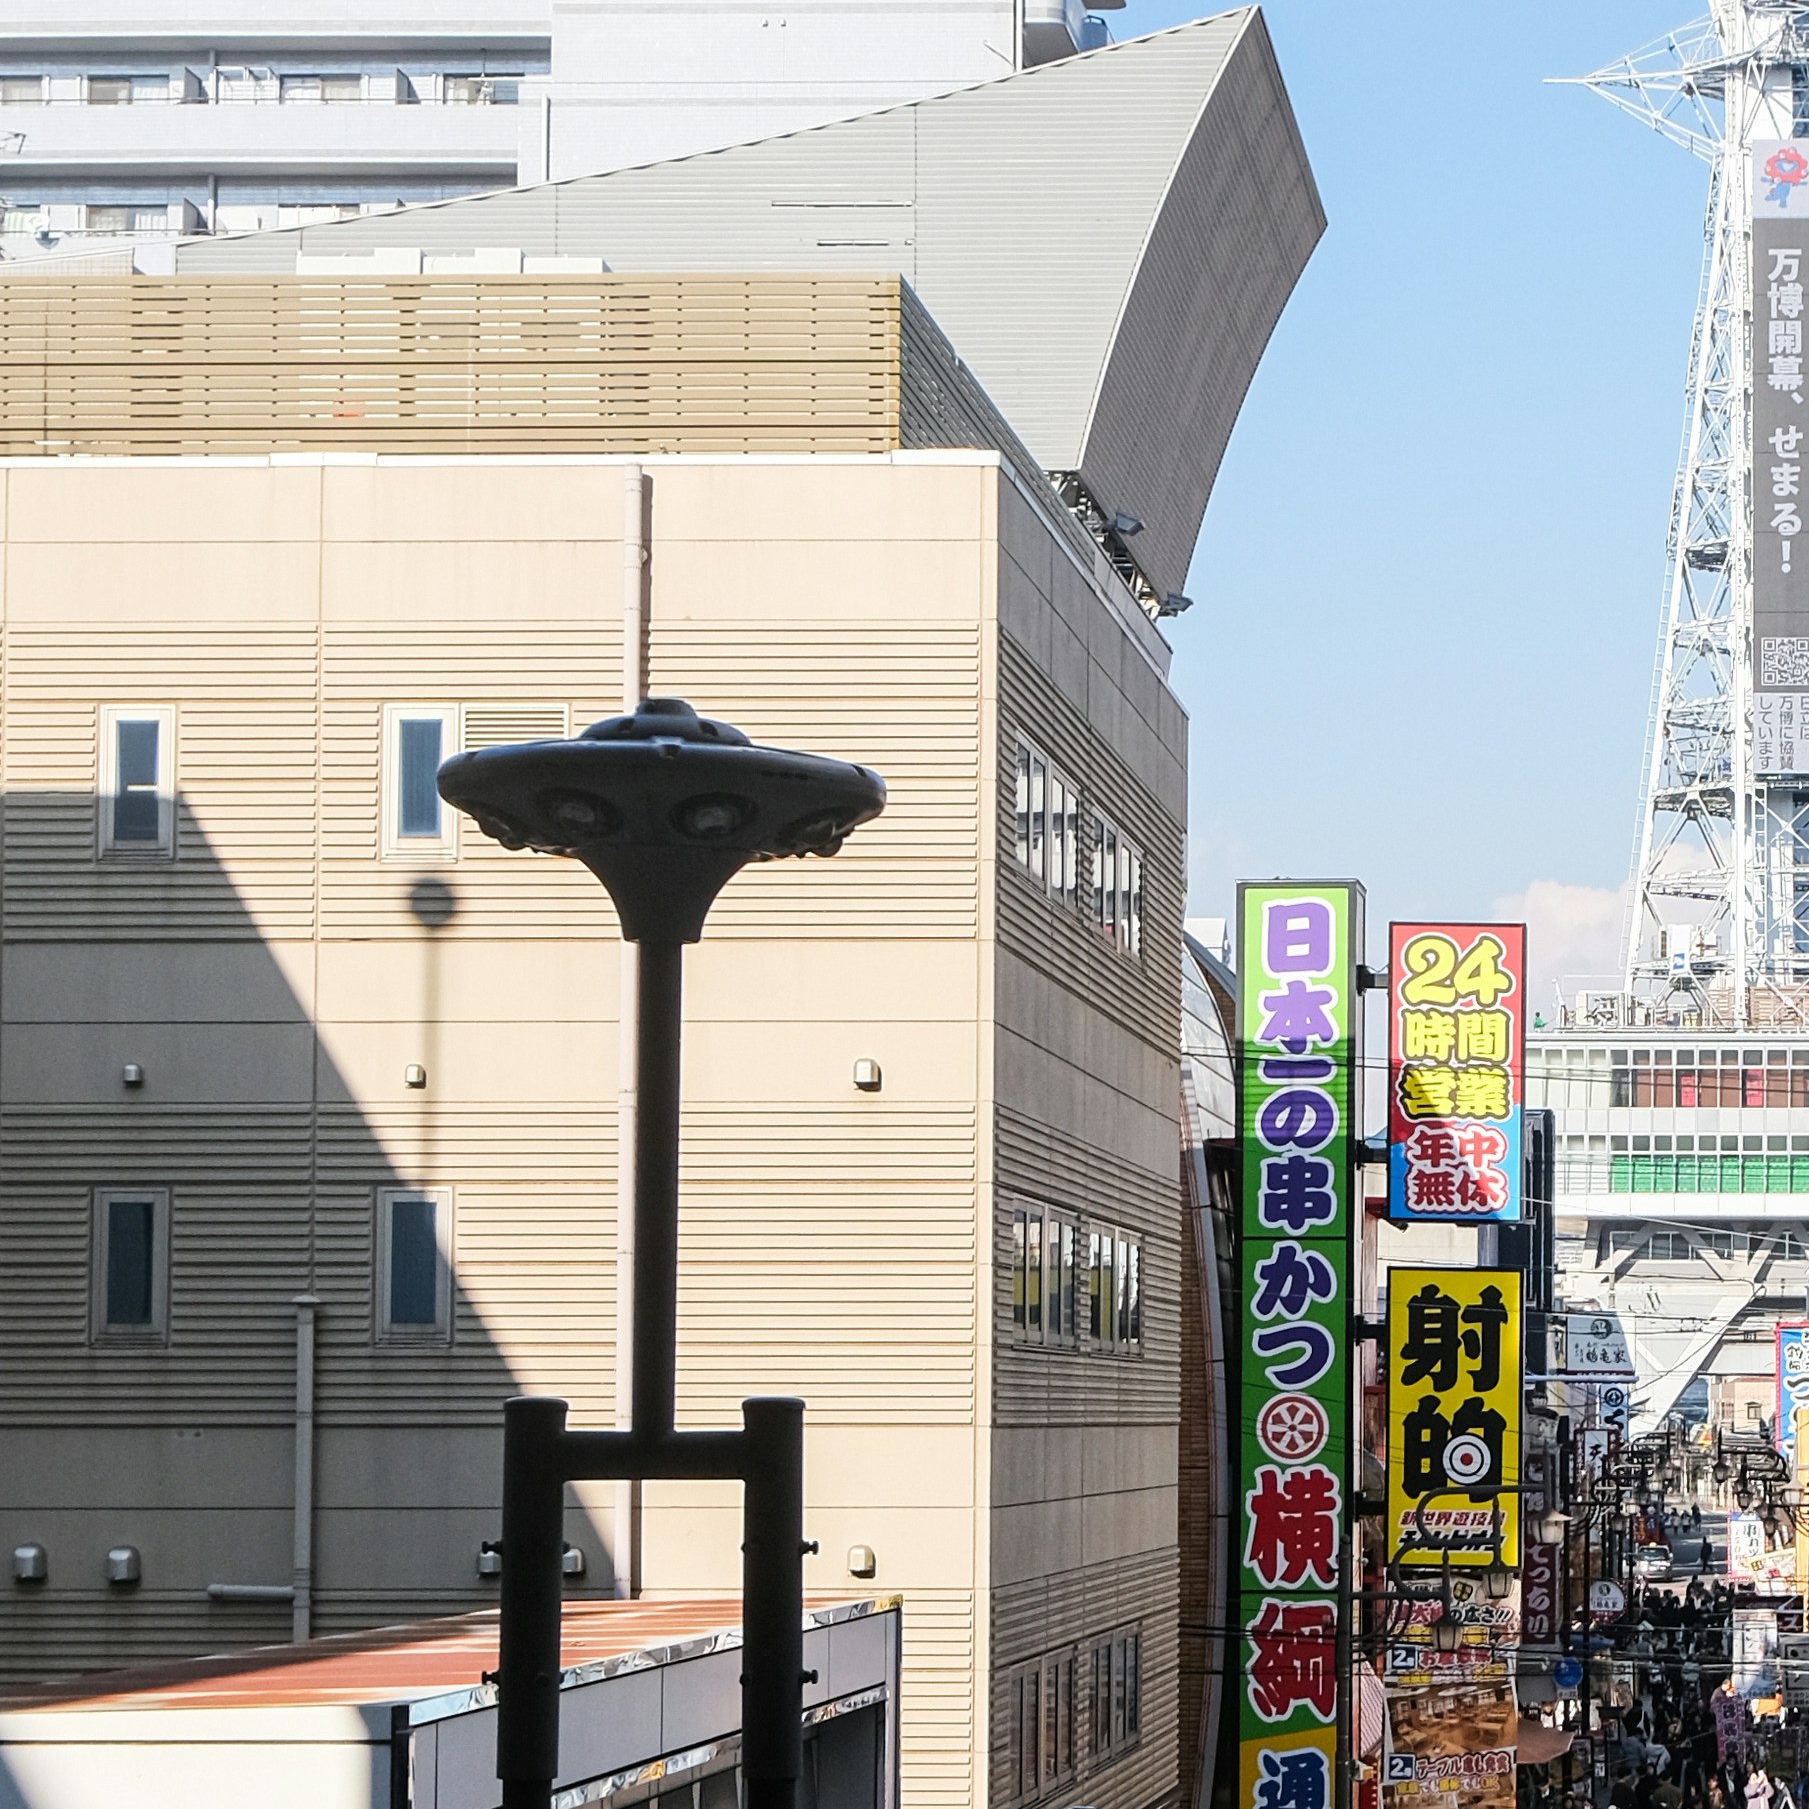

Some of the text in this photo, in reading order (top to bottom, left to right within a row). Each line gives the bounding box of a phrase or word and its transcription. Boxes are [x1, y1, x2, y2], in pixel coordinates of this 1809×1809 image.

[1758, 695, 1774, 771] しています
[1779, 695, 1795, 771] 万博に協賛
[1400, 936, 1513, 1006] 24
[1400, 1010, 1509, 1061] 時間
[1400, 1067, 1508, 1119] 営業
[1253, 901, 1337, 1385] 日本一の串かつ
[1407, 1125, 1504, 1168] 年中
[1406, 1170, 1504, 1212] 無休
[1399, 1283, 1508, 1503] 射的
[1247, 1468, 1339, 1724] 横綱
